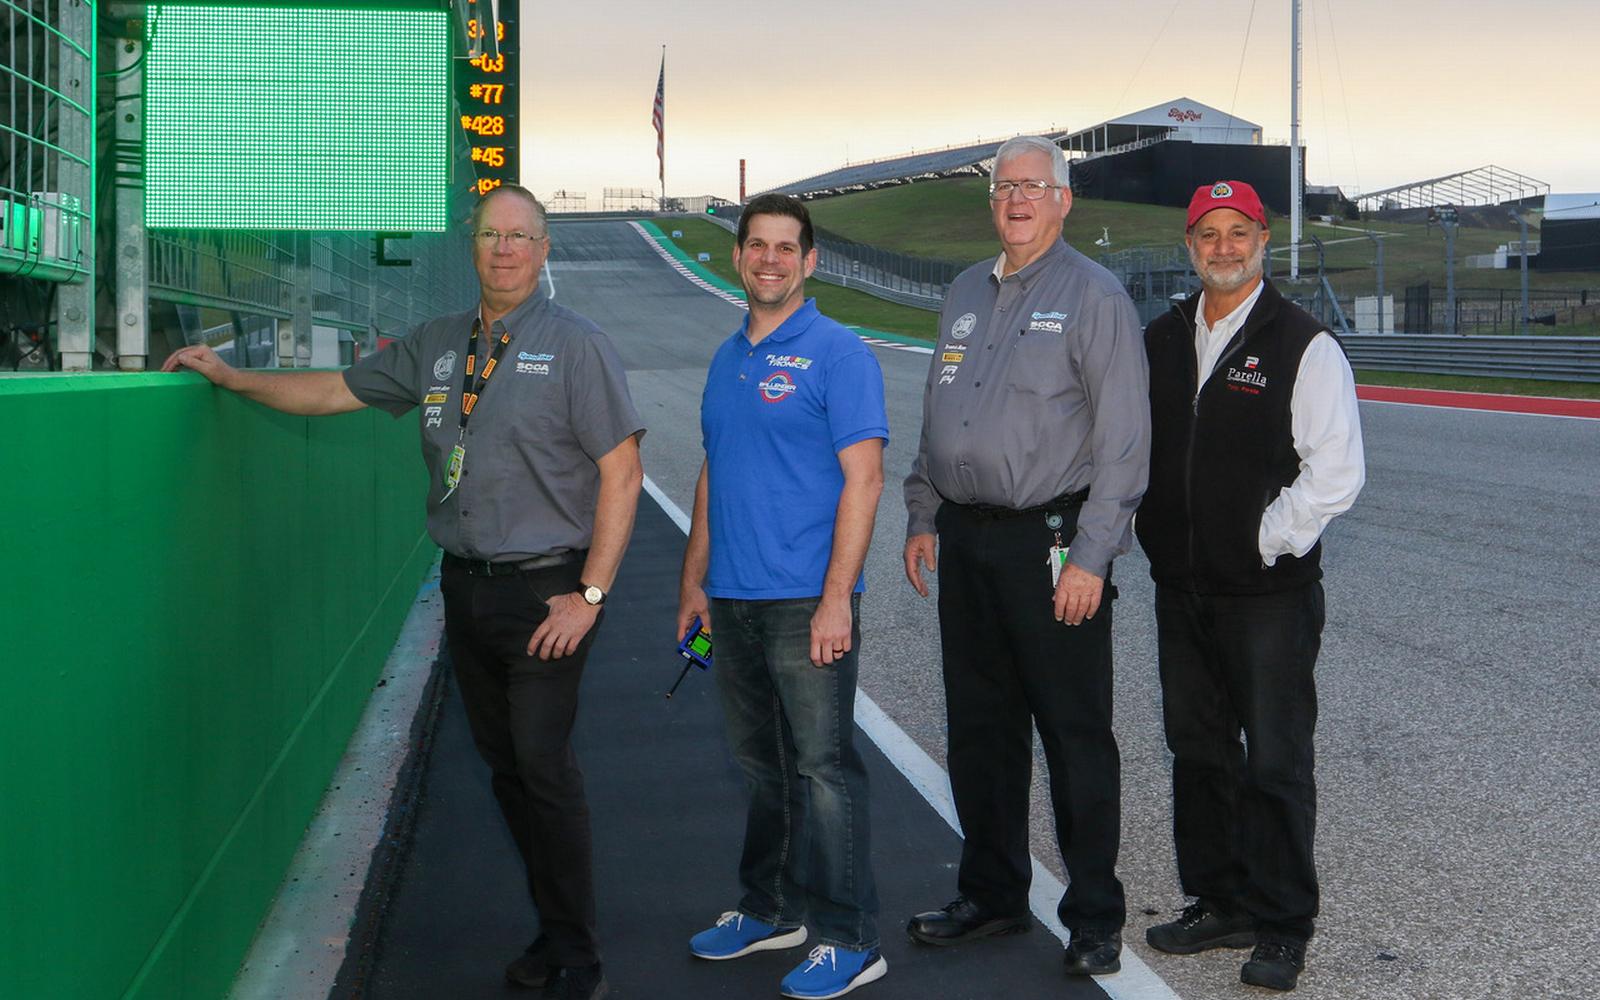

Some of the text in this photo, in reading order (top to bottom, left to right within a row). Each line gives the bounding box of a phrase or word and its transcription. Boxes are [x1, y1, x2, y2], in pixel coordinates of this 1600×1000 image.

[469, 83, 504, 105] #77
[460, 115, 505, 136] #428
[471, 147, 505, 167] #45
[1227, 367, 1267, 384] Parella
